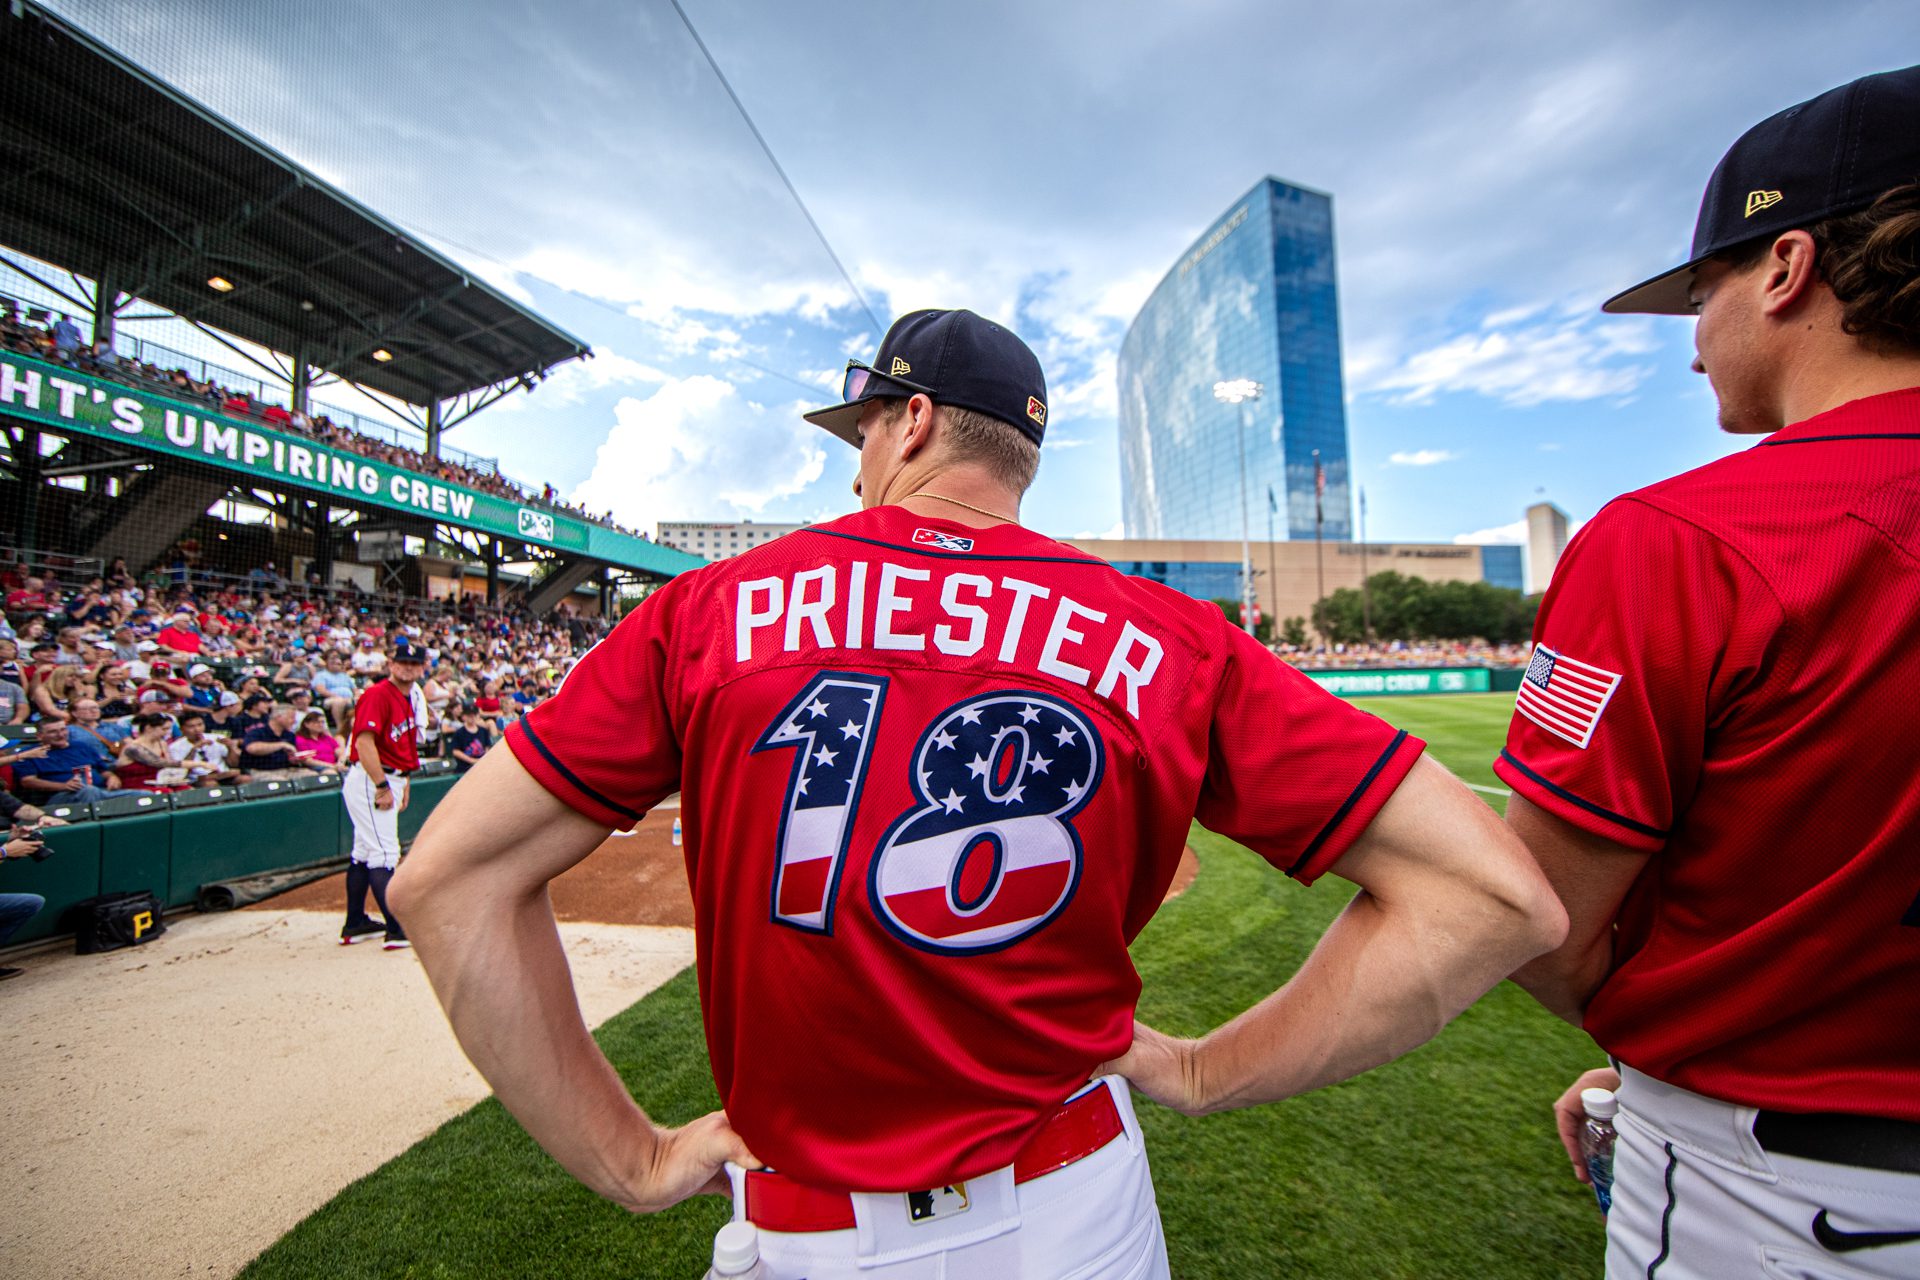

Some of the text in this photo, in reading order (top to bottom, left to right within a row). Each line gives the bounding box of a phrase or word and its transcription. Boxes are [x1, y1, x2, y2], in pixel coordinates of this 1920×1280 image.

[165, 409, 380, 495] UMPIRING
[390, 475, 475, 520] CREW
[736, 561, 1164, 719] PRIESTER
[750, 669, 1106, 957] 18
[133, 910, 153, 939] P
